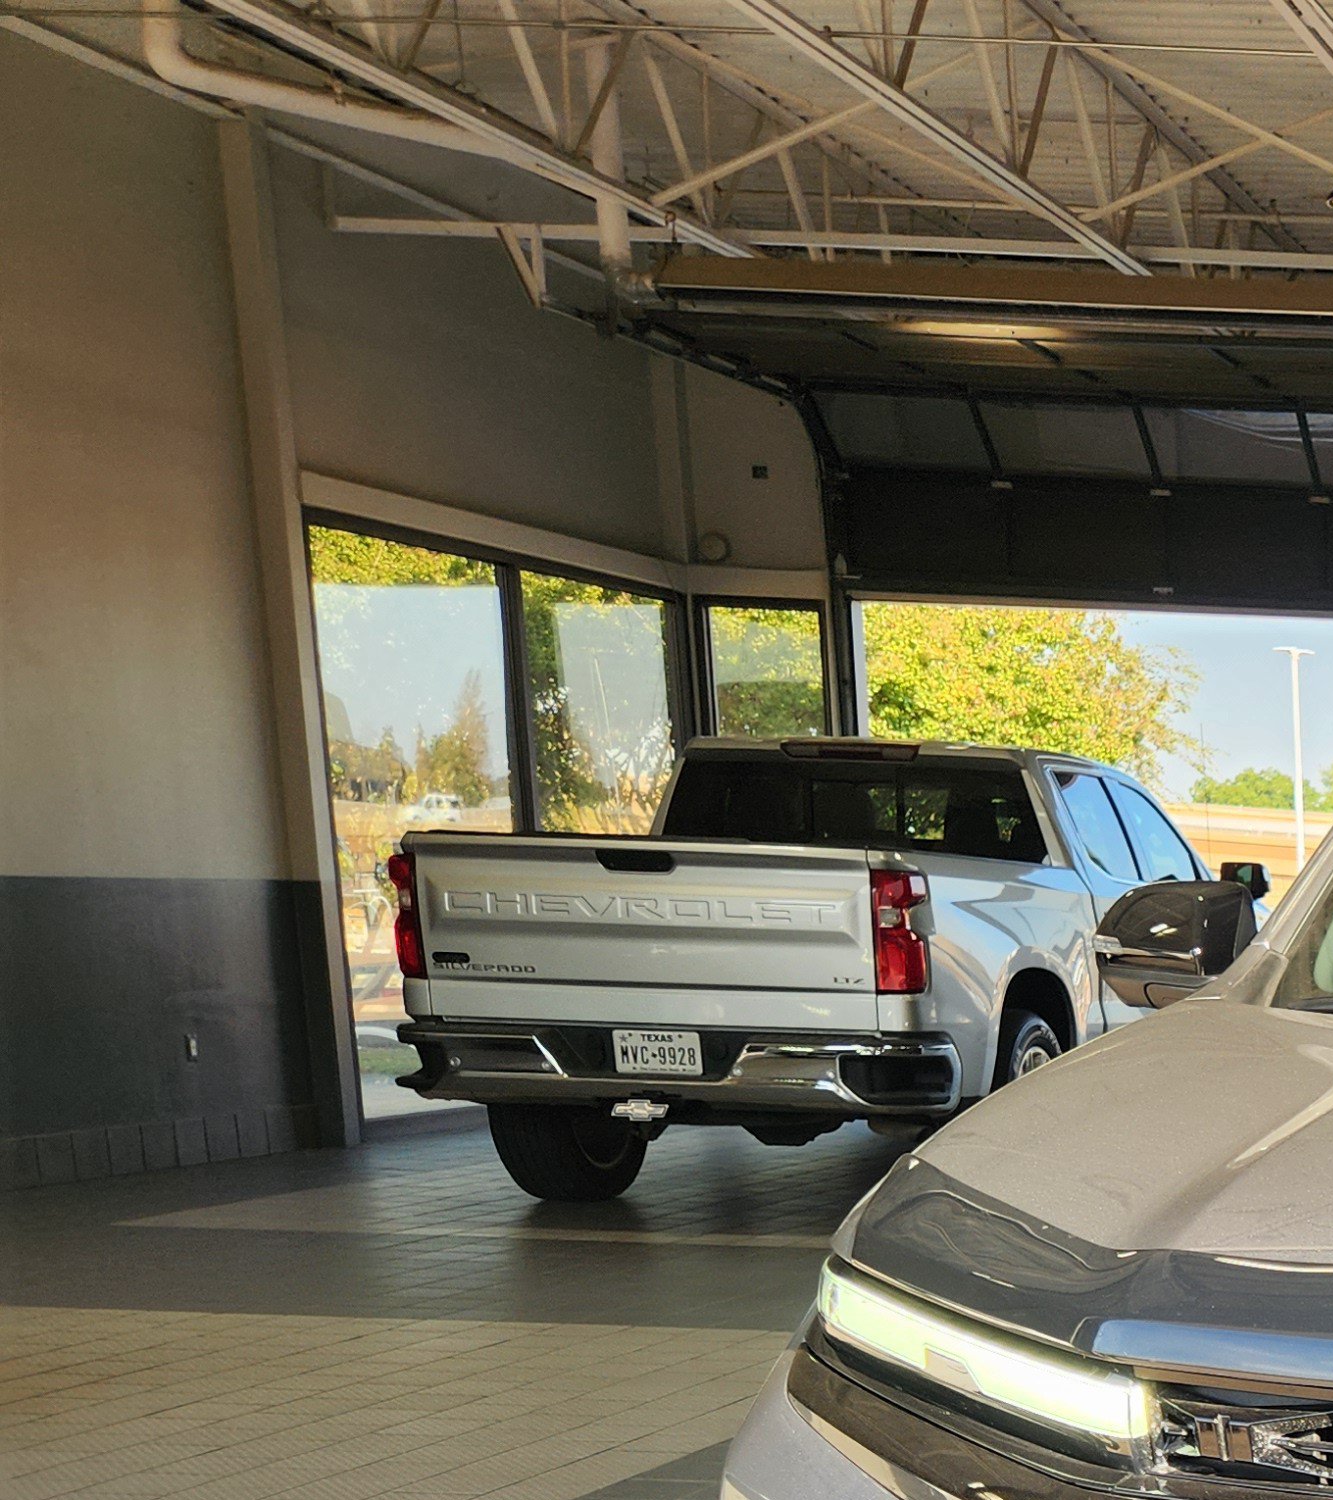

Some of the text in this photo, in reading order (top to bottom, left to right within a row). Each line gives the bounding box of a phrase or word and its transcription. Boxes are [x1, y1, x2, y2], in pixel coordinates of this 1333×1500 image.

[444, 891, 837, 925] CHEVROLET
[432, 961, 536, 974] SILVERADO
[832, 976, 865, 985] LTZ
[640, 1033, 674, 1043] TEXAS
